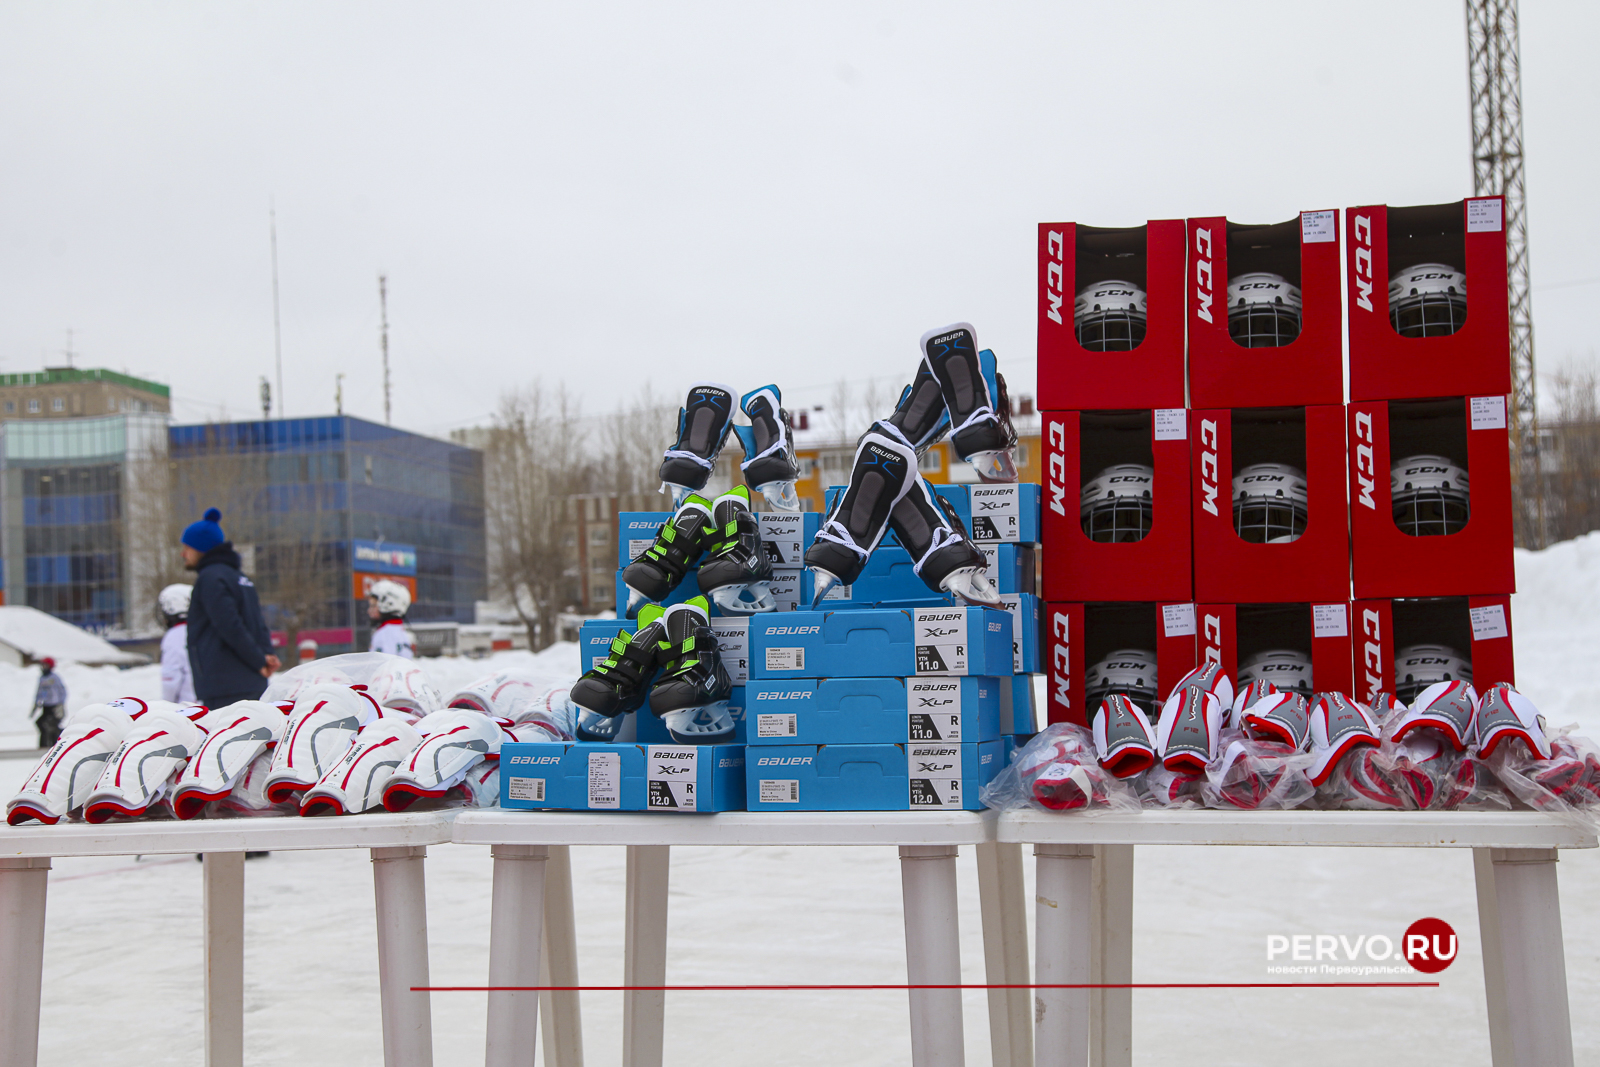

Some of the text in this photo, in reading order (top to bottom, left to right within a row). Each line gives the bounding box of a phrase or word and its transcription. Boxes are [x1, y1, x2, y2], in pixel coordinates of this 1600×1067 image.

[1355, 215, 1373, 312] CCM
[1047, 230, 1063, 325] CCM
[1196, 227, 1213, 323] CCM
[1410, 273, 1453, 282] CCM
[1239, 283, 1280, 291] CCM
[1094, 289, 1134, 298] CCM
[934, 331, 964, 344] BAUER
[696, 388, 726, 397] BAUER
[870, 445, 901, 463] BAUER
[1356, 411, 1375, 510] CCM
[1050, 420, 1065, 516] CCM
[1201, 419, 1218, 516] CCM
[1405, 467, 1448, 475] CCM
[1109, 475, 1150, 484] CCM
[1243, 475, 1285, 483] CCM
[979, 502, 1010, 510] XLP
[1009, 517, 1016, 525] R
[766, 527, 796, 535] XLP
[975, 530, 993, 538] 12.0
[793, 543, 800, 551] R
[791, 602, 797, 611] R
[765, 626, 820, 635] BAUER
[924, 628, 958, 637] XLP
[957, 646, 964, 656] R
[1363, 608, 1382, 701] CCM
[739, 660, 746, 668] R
[1053, 612, 1070, 708] CCM
[1406, 658, 1449, 666] CCM
[919, 661, 939, 670] 11.0
[1106, 662, 1146, 670] CCM
[757, 691, 812, 700] BAUER
[918, 698, 953, 707] XLP
[1450, 701, 1464, 713] F12
[1290, 709, 1302, 721] F12
[1485, 709, 1499, 718] F12
[951, 716, 958, 725] R
[913, 730, 932, 739] 11.0
[1184, 726, 1199, 734] F12
[510, 756, 560, 765] BAUER
[719, 758, 744, 768] BAUER
[757, 757, 812, 766] BAUER
[657, 765, 690, 775] XLP
[918, 762, 953, 772] XLP
[687, 784, 693, 793] R
[951, 781, 959, 790] R
[651, 797, 669, 805] 12.0
[913, 795, 933, 803] 12.0
